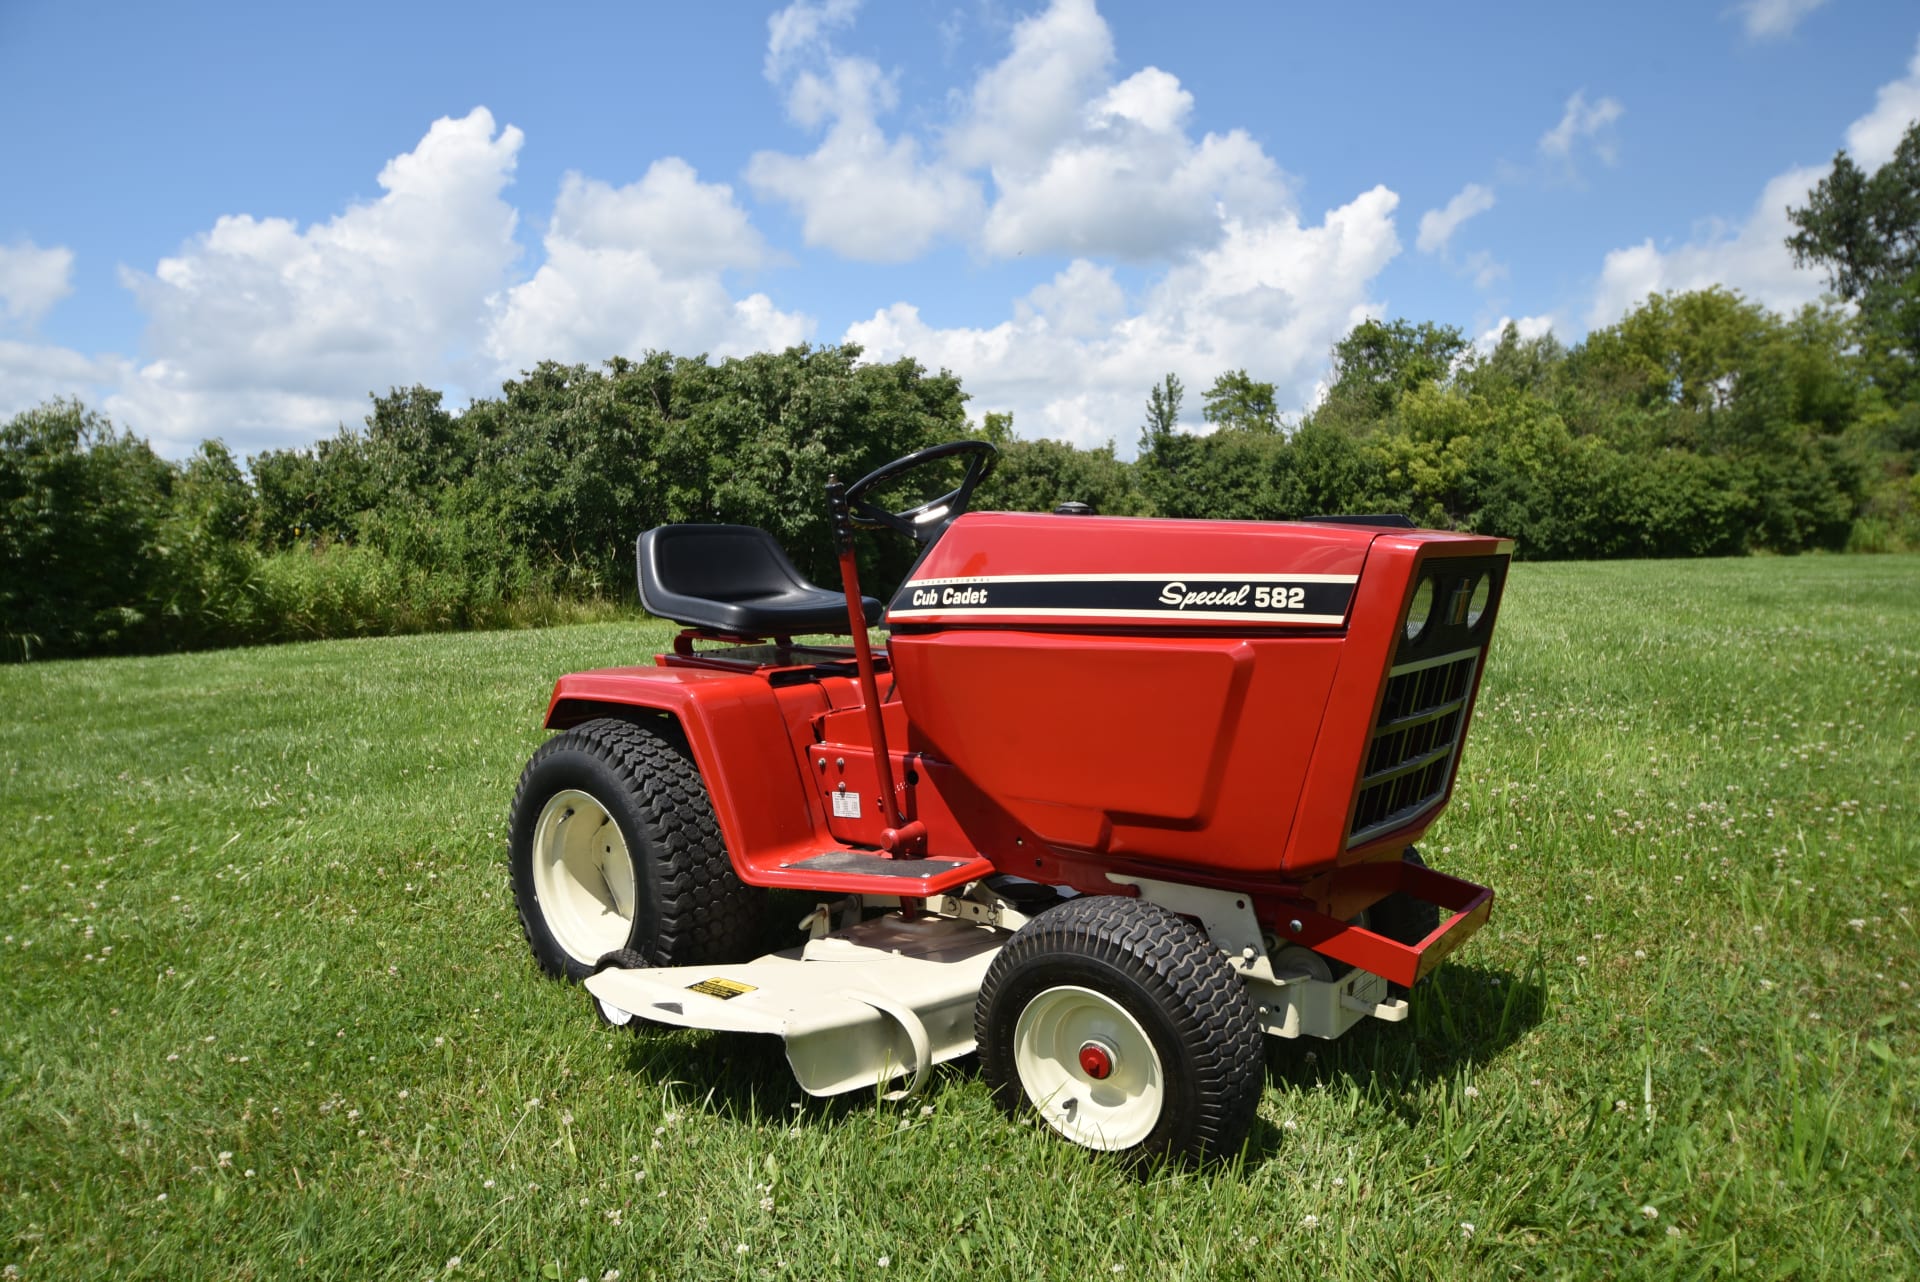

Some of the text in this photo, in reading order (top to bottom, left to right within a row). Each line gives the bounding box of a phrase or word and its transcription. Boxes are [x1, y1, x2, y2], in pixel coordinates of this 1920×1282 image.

[912, 586, 988, 606] Cub Cadet
[1158, 582, 1305, 610] Special 582
